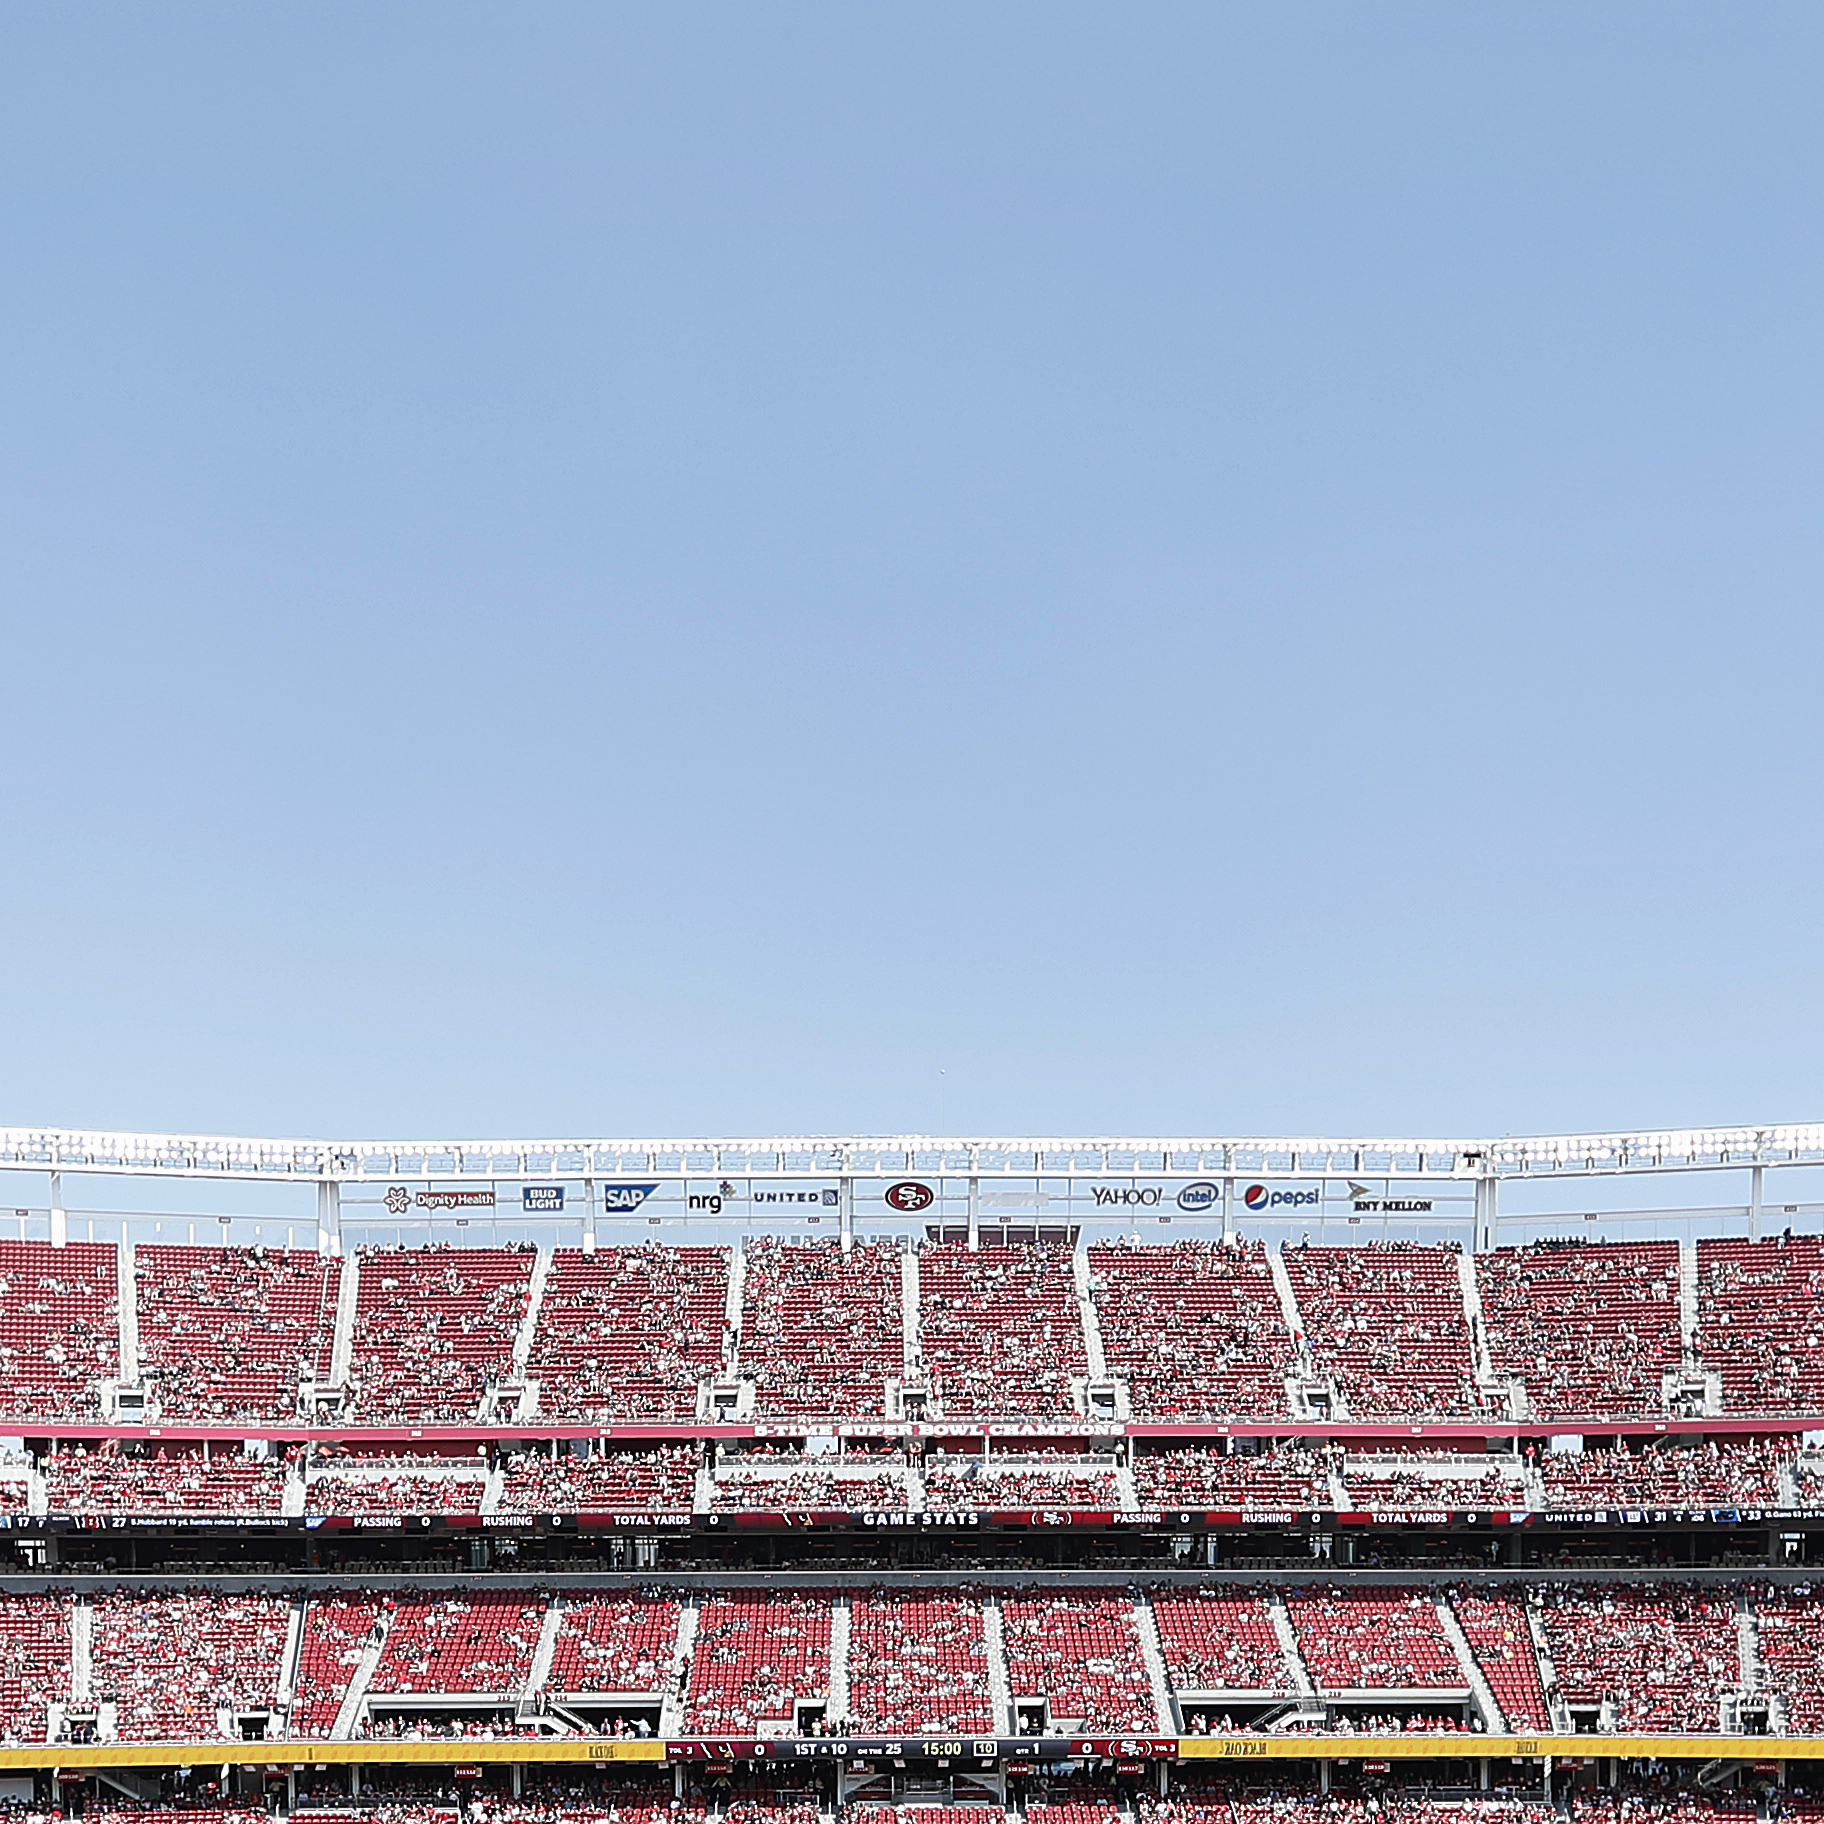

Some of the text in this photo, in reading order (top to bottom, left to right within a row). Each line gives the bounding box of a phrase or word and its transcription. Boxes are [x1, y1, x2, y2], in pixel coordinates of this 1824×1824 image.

[530, 1190, 556, 1198] BUD
[607, 1190, 644, 1207] SAP
[754, 1193, 818, 1202] UNITED
[1092, 1188, 1162, 1205] YAHOO!
[1183, 1190, 1212, 1203] intel
[1271, 1189, 1319, 1208] pepsi
[417, 1193, 494, 1209] Dignity Health
[526, 1199, 561, 1208] LIGHT
[689, 1194, 721, 1213] nrg
[1354, 1201, 1431, 1211] BNY MELLON
[754, 1425, 1125, 1436] 5-TIME SUPER BOWL CHAMPIONS
[354, 1515, 718, 1527] PASSING 0 RUSHING 0 TOTAL YARDS 0
[864, 1513, 978, 1525] GAME STATS
[1113, 1513, 1476, 1524] PASSING 0 RUSHING 0 TOTAL YARDS 0
[1655, 1512, 1666, 1521] 31
[1748, 1511, 1761, 1520] 33
[1803, 1511, 1813, 1519] yd.
[18, 1517, 29, 1526] 17
[113, 1518, 188, 1527] 27 yd.
[754, 1744, 764, 1755] 0
[795, 1743, 902, 1755] 1ST 10 25
[922, 1743, 961, 1755] 15:00
[979, 1744, 992, 1753] 10
[1082, 1743, 1092, 1754] 0
